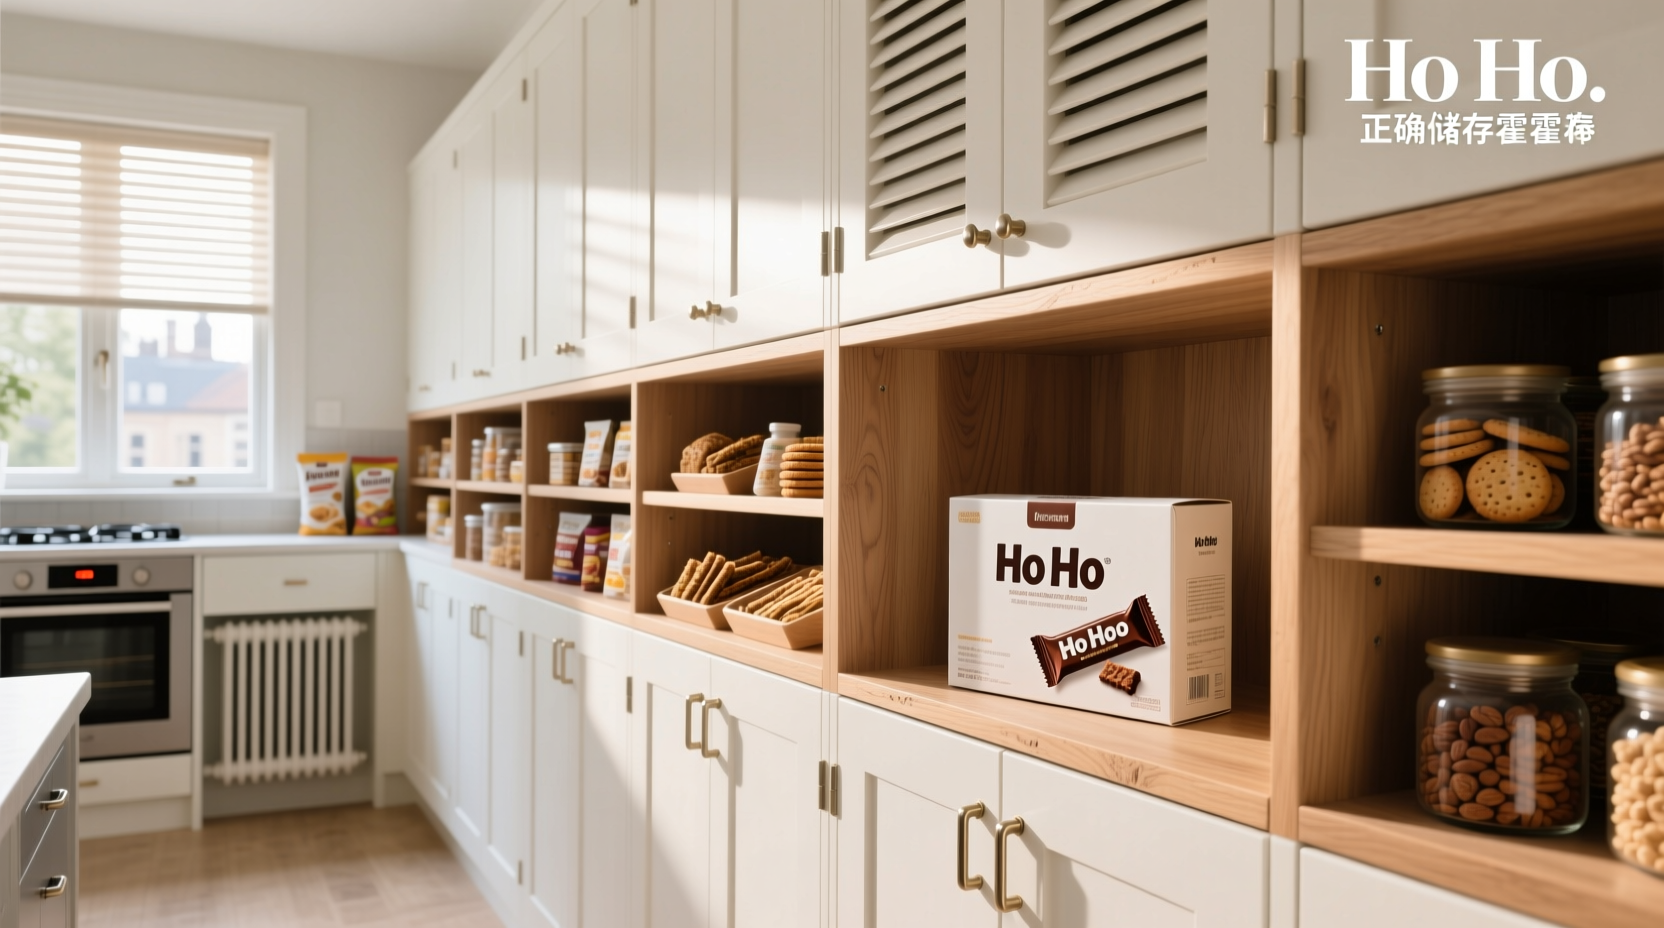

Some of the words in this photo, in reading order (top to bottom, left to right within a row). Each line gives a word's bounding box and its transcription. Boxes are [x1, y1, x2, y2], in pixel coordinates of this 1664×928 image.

[995, 543, 1046, 586] Ho
[1050, 546, 1105, 590] Ho
[1058, 636, 1088, 660] Ho
[1087, 621, 1129, 649] Hoo
